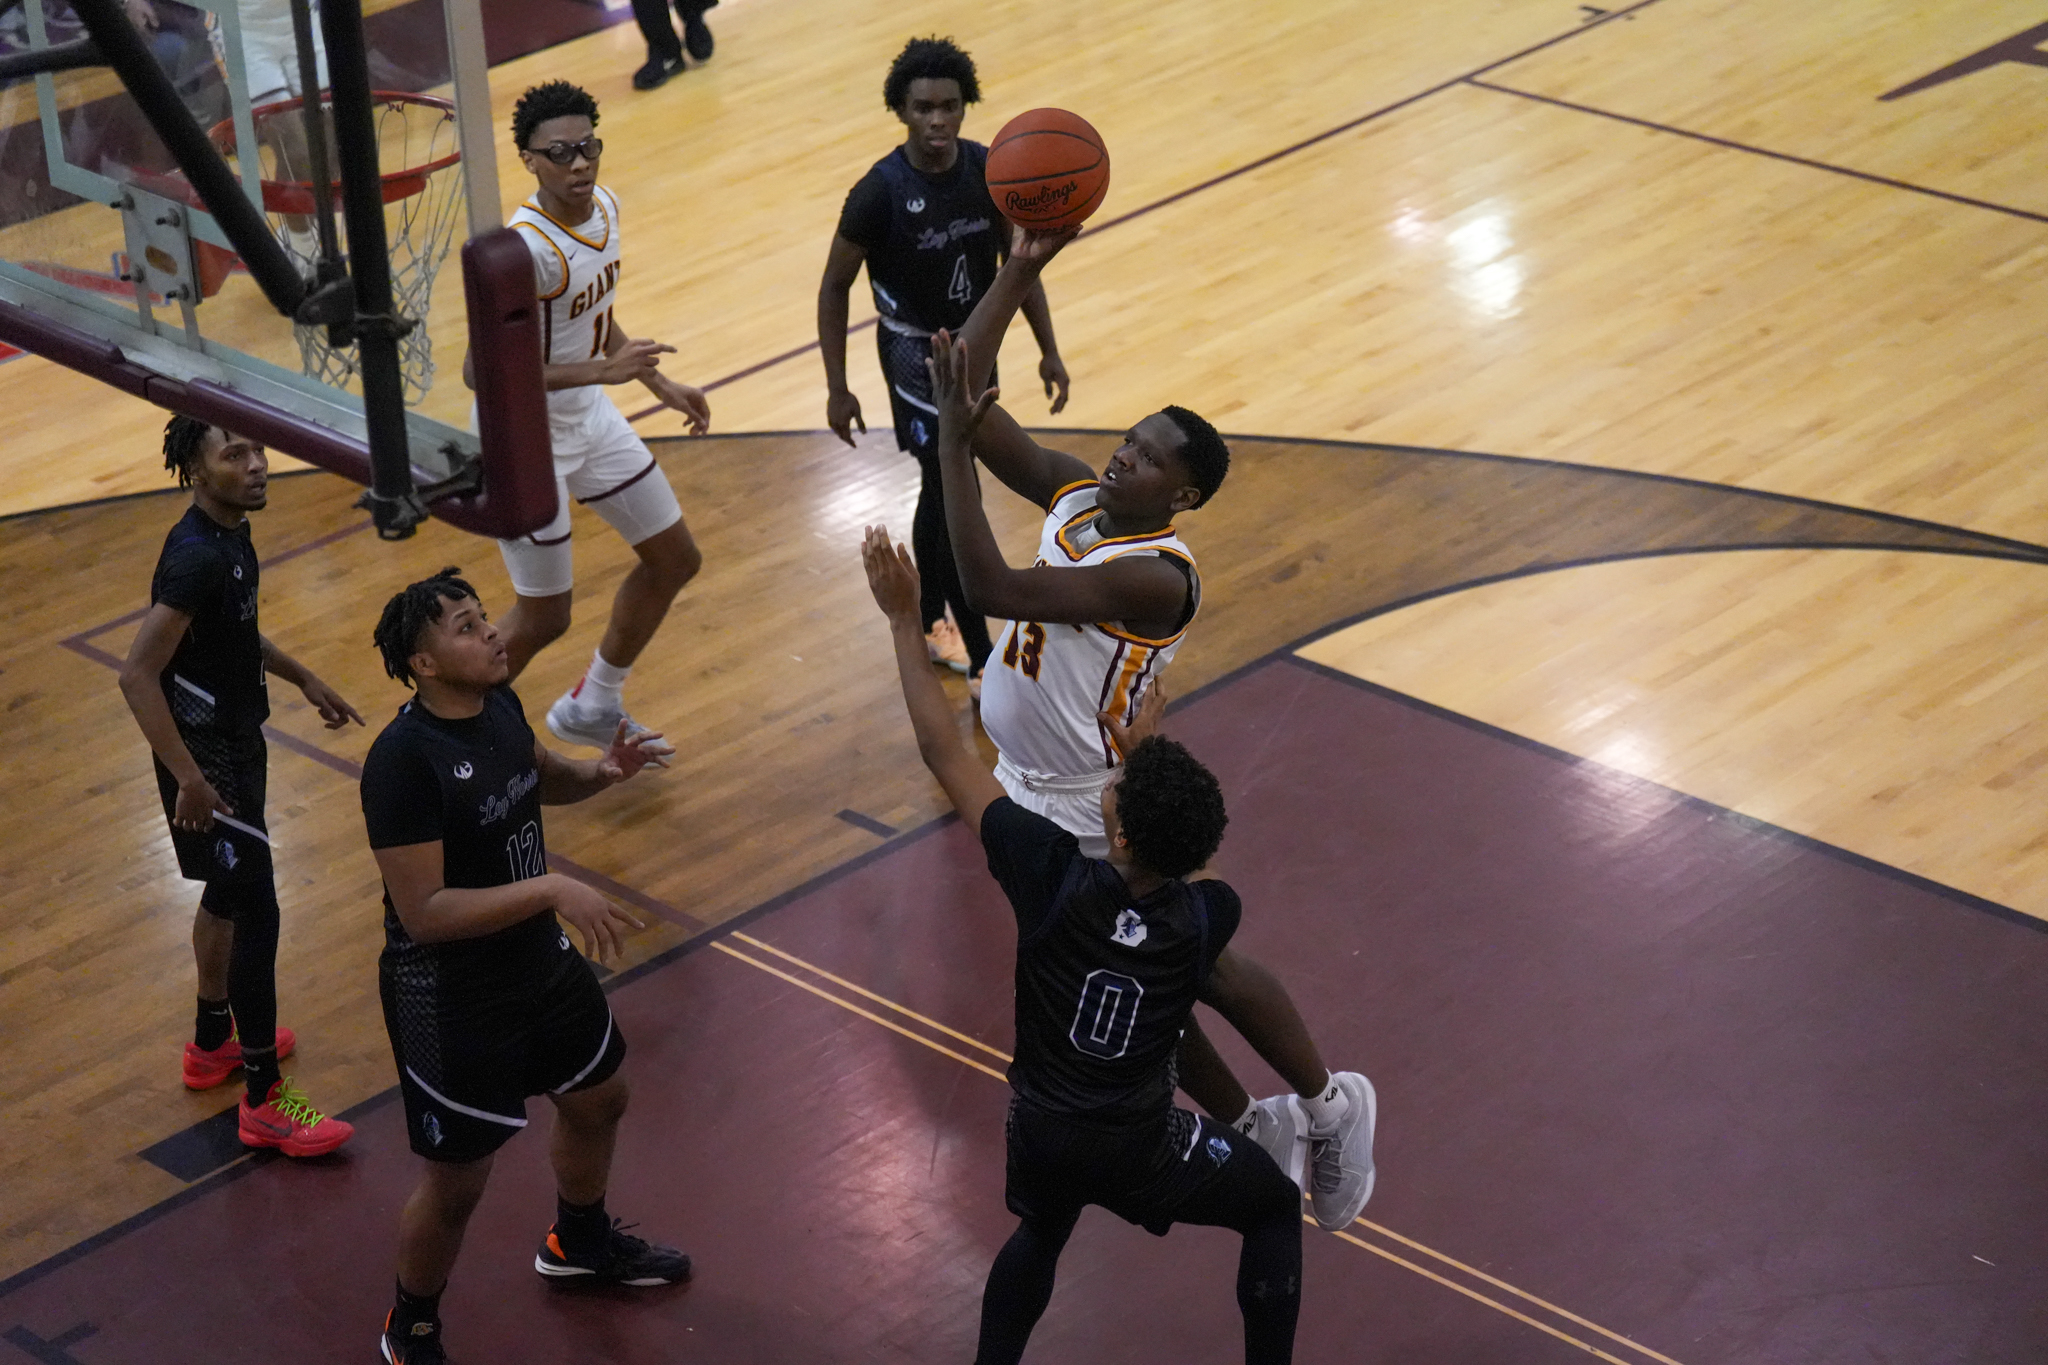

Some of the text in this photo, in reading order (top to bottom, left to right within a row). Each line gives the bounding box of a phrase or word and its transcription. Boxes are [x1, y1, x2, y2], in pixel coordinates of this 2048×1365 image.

[1005, 181, 1078, 212] Rawlings
[948, 253, 973, 305] 4
[1002, 620, 1047, 683] 13
[506, 819, 545, 883] 12
[1069, 968, 1144, 1060] 0
